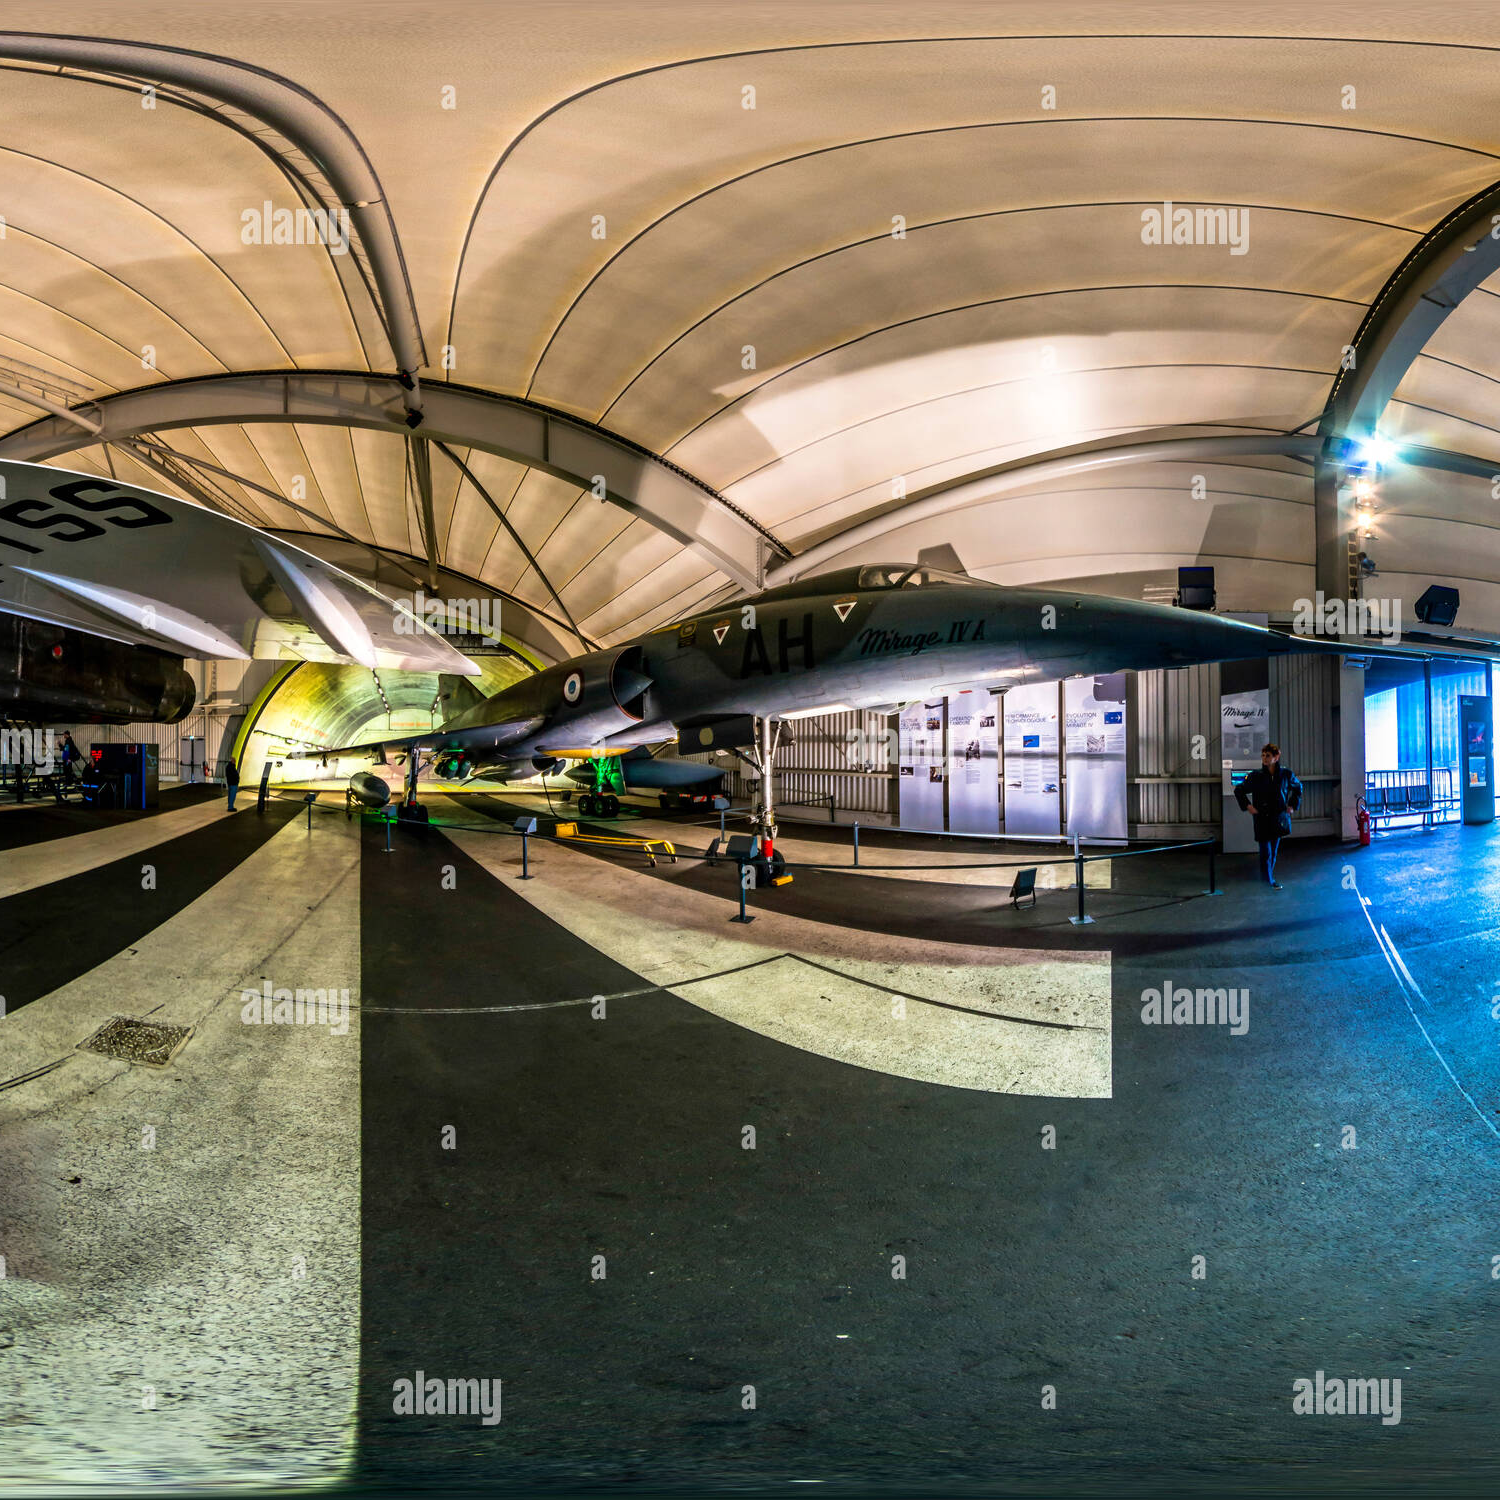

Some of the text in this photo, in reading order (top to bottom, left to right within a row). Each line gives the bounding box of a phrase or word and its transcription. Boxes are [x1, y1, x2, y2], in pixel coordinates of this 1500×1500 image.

[740, 613, 815, 680] AH
[858, 619, 986, 656] Mirage IV A
[1223, 706, 1255, 719] Mirage
